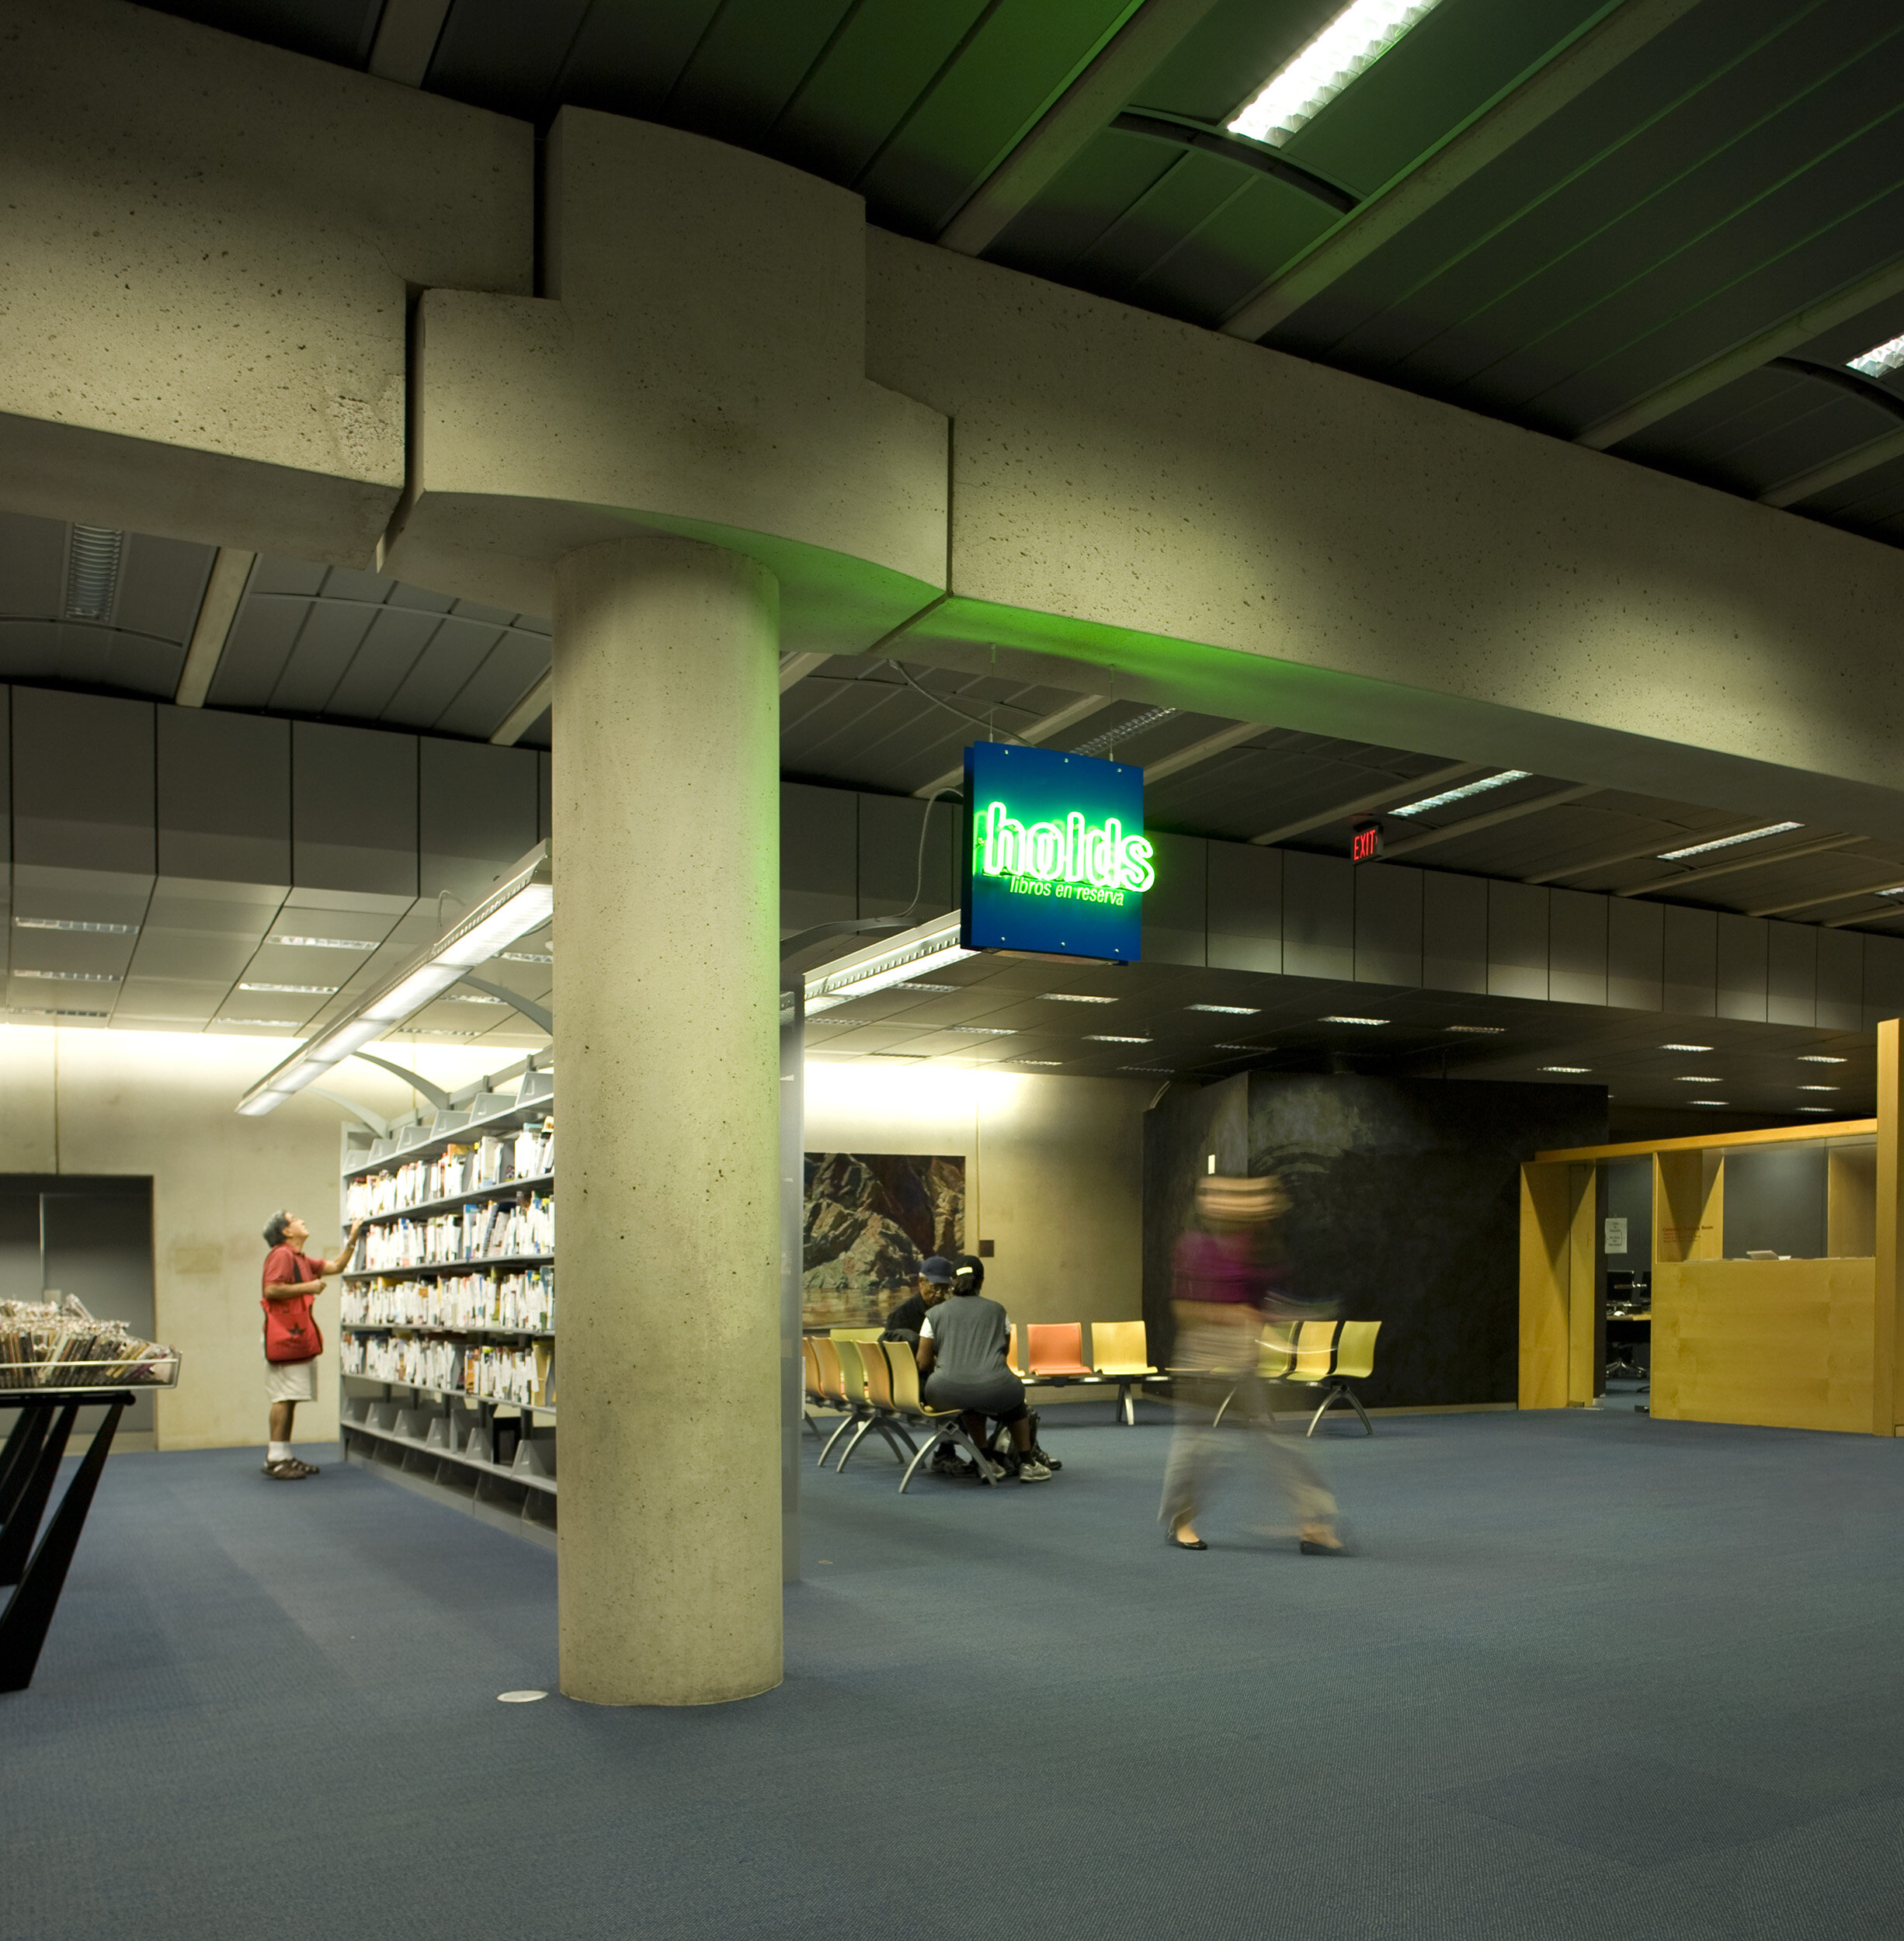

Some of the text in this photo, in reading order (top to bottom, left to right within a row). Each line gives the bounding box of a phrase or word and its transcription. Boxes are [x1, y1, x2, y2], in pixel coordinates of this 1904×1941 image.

[984, 801, 1155, 893] holds
[1353, 828, 1376, 861] EXIT
[1009, 875, 1124, 906] libros en reserva
